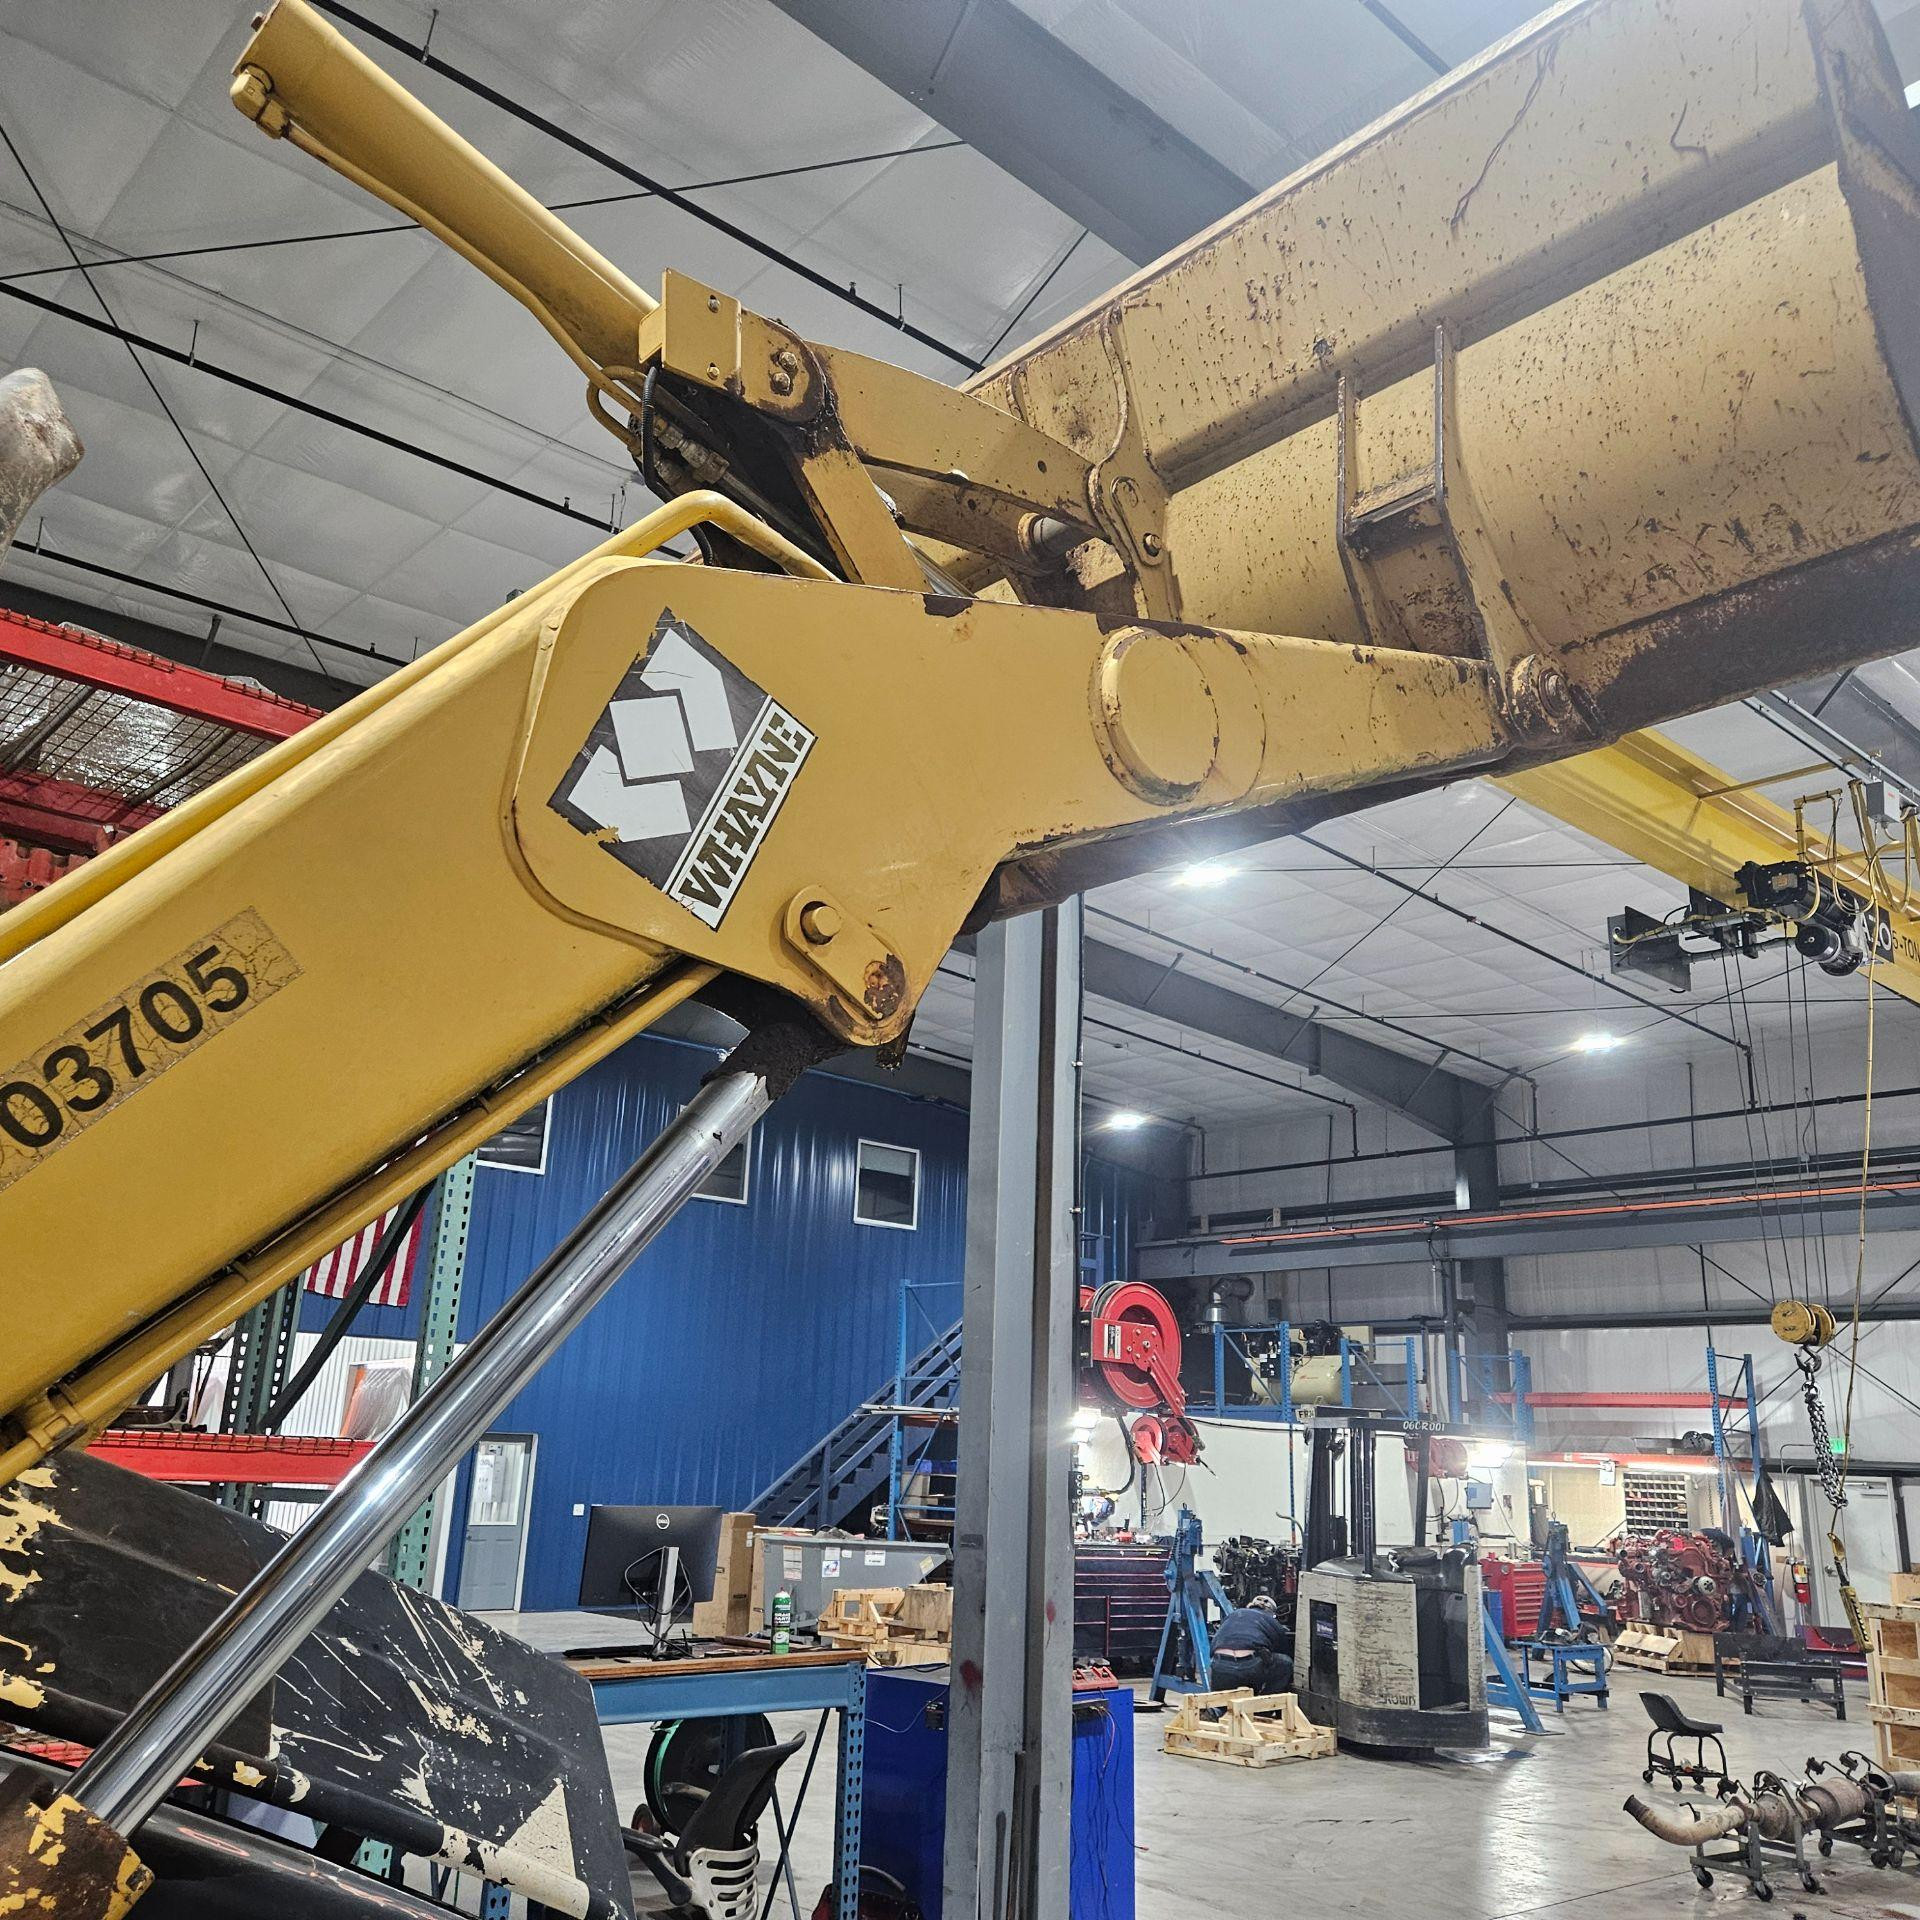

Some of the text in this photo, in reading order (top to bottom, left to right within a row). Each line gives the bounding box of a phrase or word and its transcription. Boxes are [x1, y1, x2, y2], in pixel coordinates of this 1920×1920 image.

[678, 712, 807, 909] WHAYNE
[0, 945, 249, 1148] 03705
[1402, 1420, 1445, 1432] 06CR001
